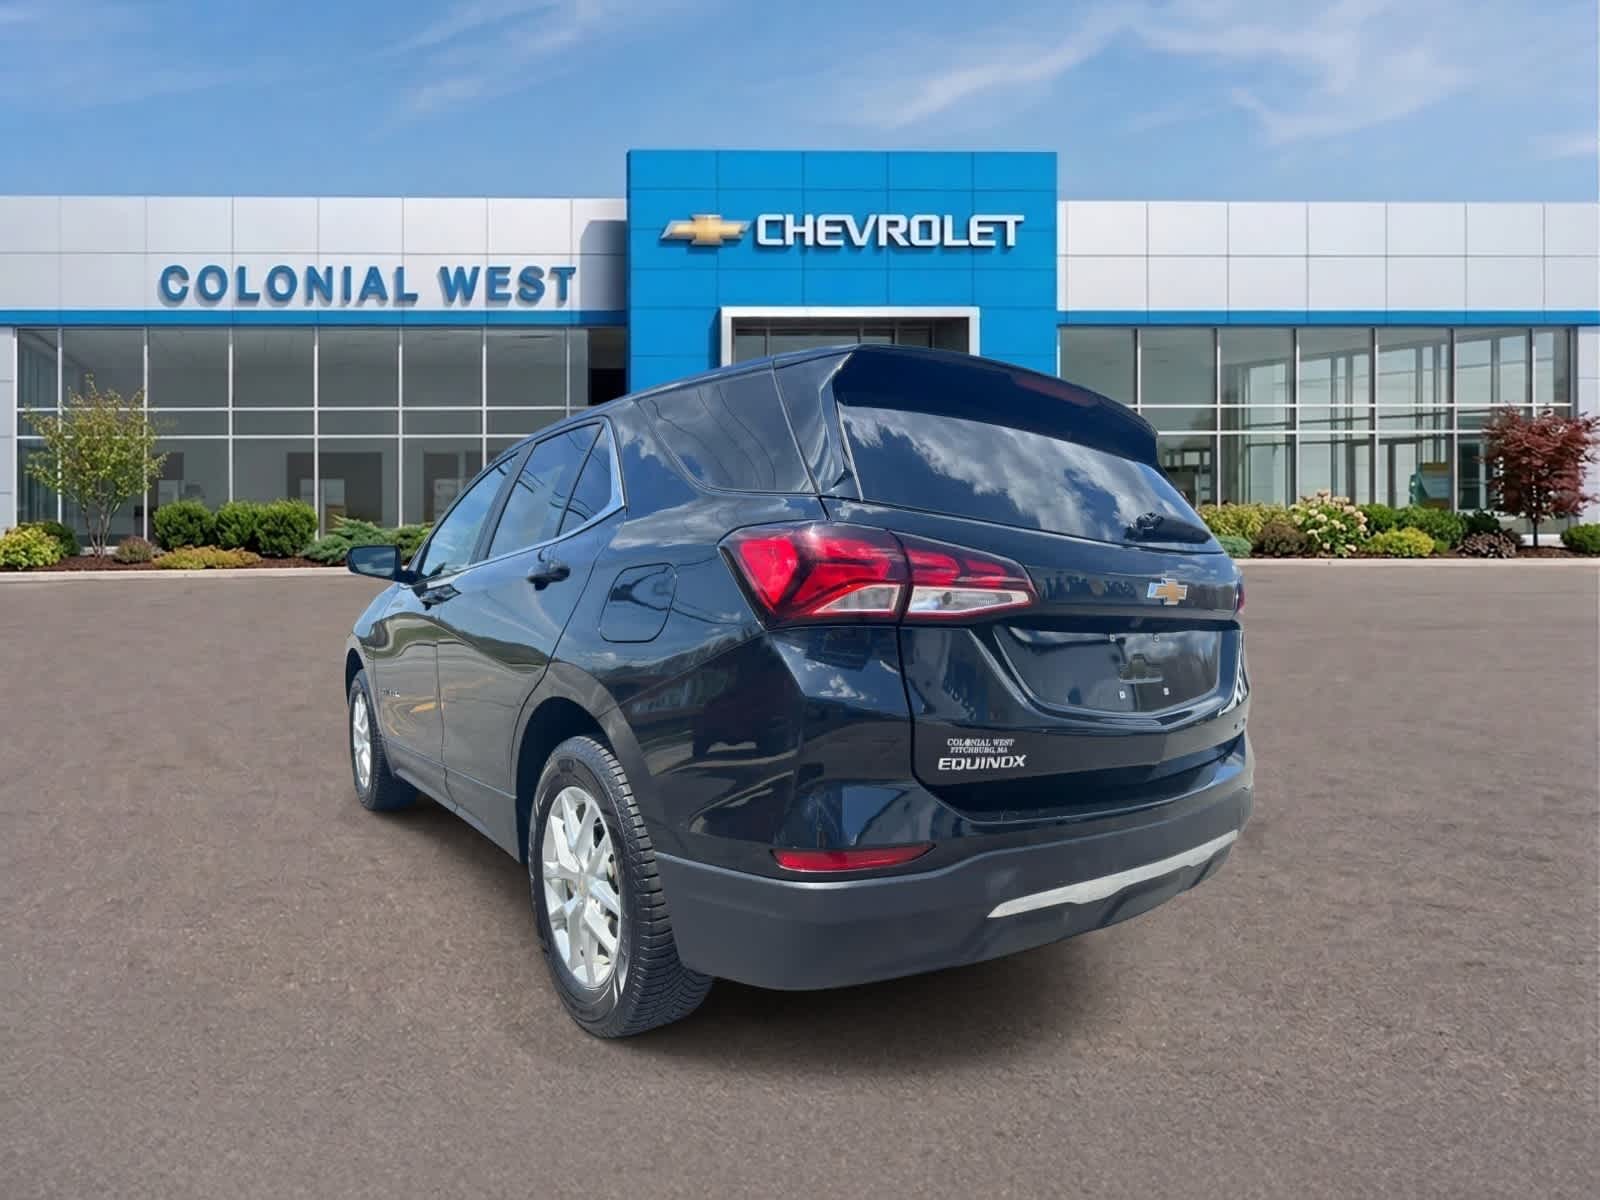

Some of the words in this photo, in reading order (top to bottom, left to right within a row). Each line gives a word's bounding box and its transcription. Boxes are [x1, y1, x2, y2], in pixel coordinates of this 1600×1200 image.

[755, 213, 1024, 248] CHEVROLET
[159, 264, 418, 305] COLONIAL
[436, 265, 577, 305] WEST
[947, 738, 991, 747] COLONIAL
[993, 738, 1015, 747] WEST
[937, 754, 1027, 771] EQUINOX
